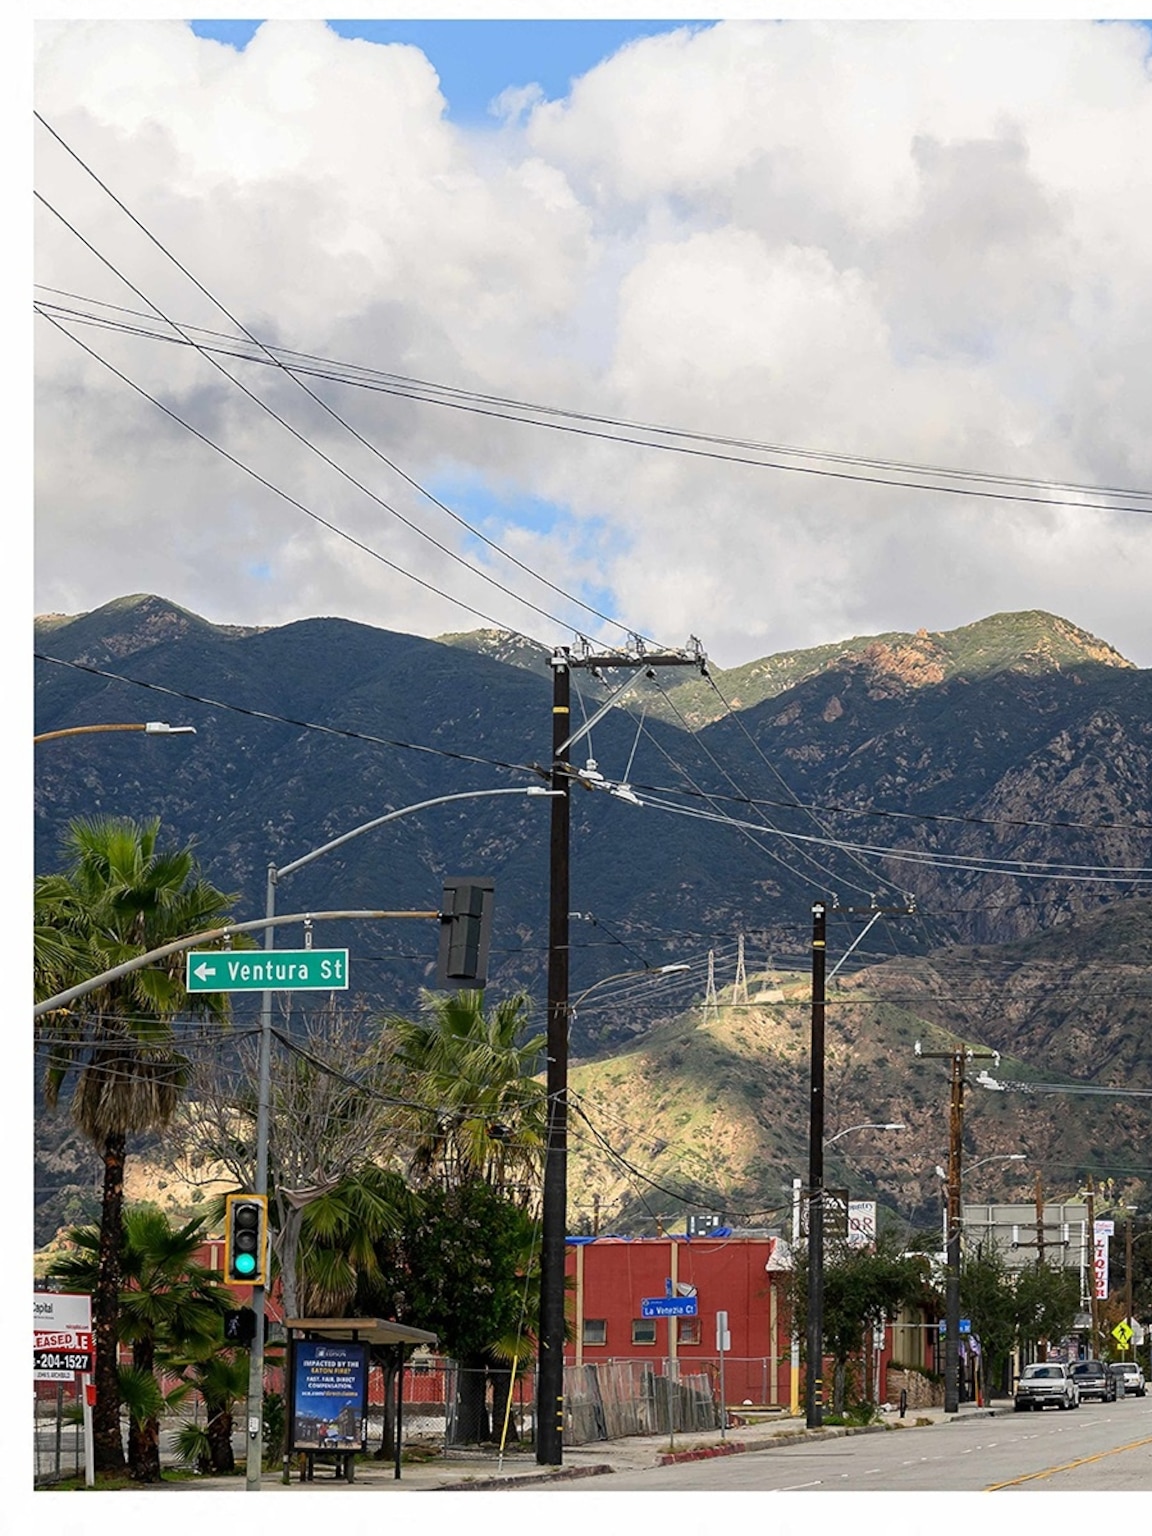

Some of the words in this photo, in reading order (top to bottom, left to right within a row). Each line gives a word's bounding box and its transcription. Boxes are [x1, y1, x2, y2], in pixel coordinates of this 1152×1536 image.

[228, 960, 308, 981] Ventura
[320, 959, 343, 979] St
[1094, 1239, 1105, 1297] LIQUOR
[644, 1307, 654, 1315] La
[685, 1305, 694, 1314] Ct
[34, 1333, 73, 1349] EASED
[303, 1360, 336, 1368] IMPACTED
